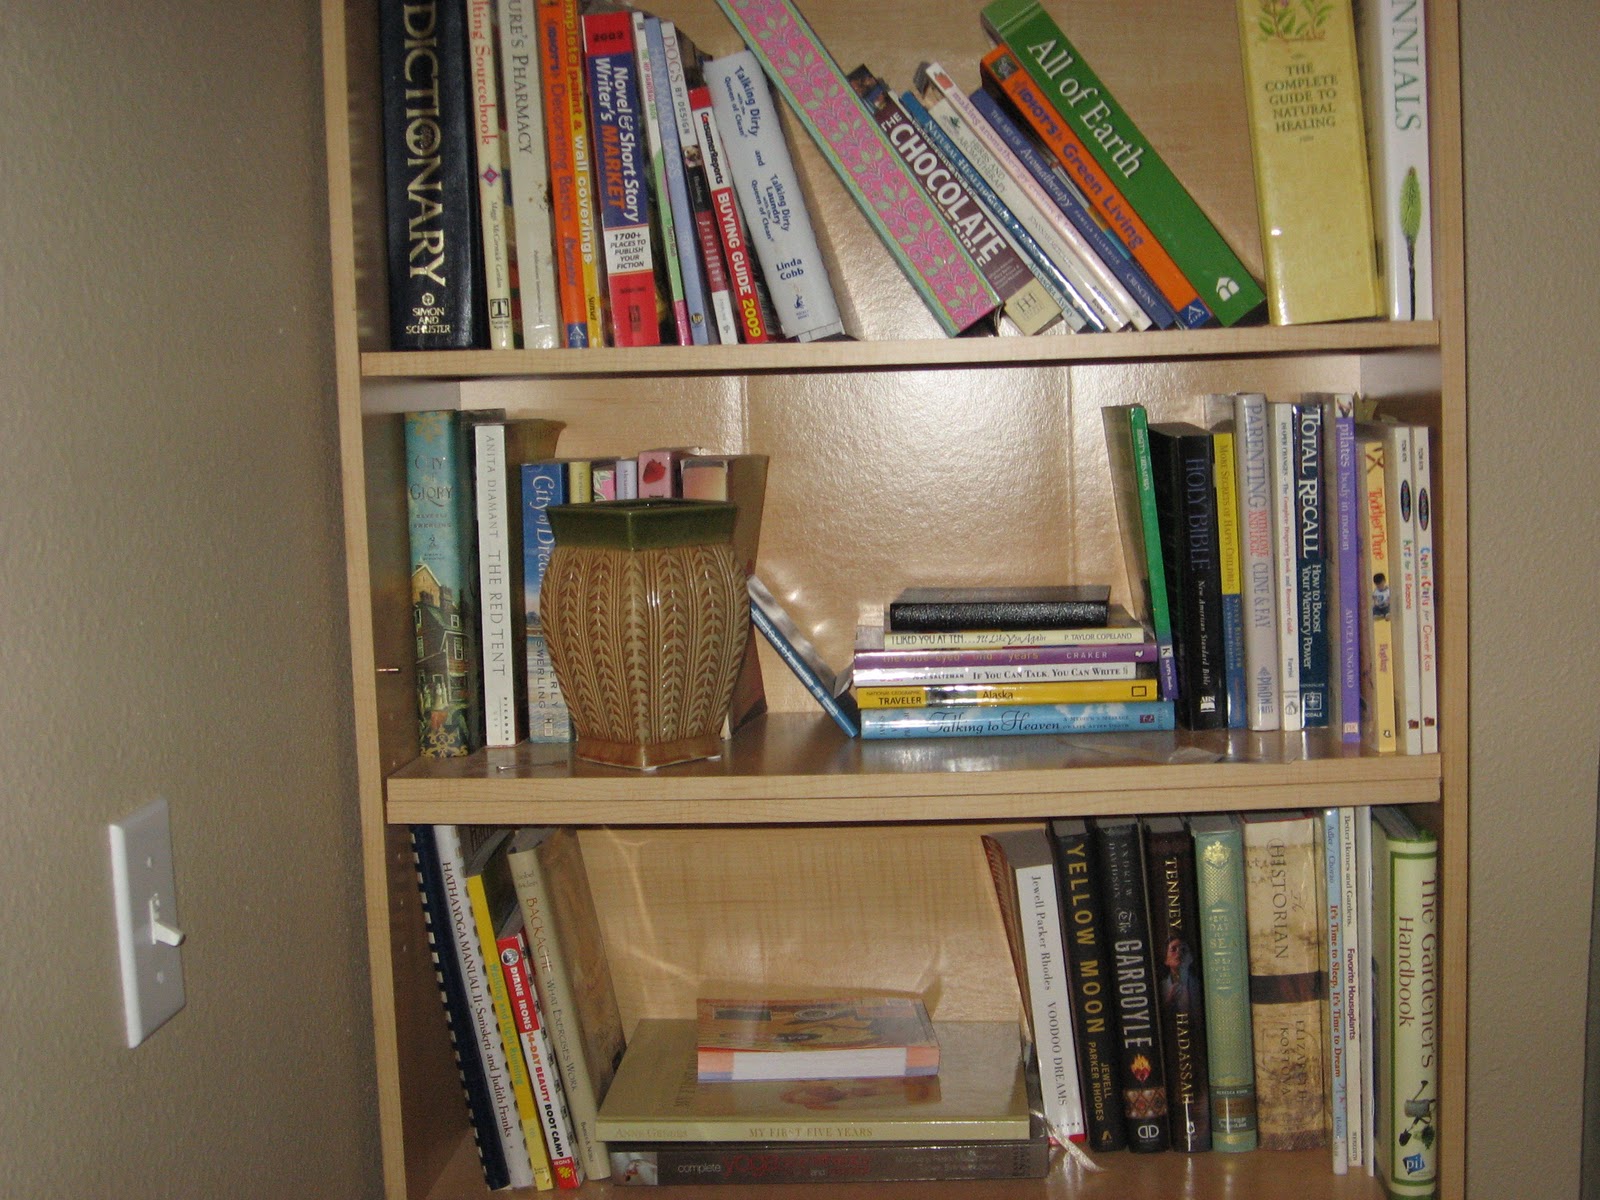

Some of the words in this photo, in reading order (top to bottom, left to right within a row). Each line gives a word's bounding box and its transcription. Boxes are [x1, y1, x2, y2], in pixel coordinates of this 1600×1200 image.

[663, 35, 682, 83] DOGS
[677, 101, 690, 135] DESIGN
[1264, 74, 1338, 92] COMPLETE
[1285, 63, 1314, 75] THE
[475, 46, 498, 145] Sourcebook
[512, 54, 532, 154] PHARMACY
[568, 70, 582, 117] paint
[595, 57, 616, 121] Writer's
[613, 66, 632, 113] Novel
[735, 65, 755, 106] Talking
[748, 108, 763, 138] Dirty
[1269, 89, 1312, 106] GUIDE
[1316, 88, 1337, 100] TO
[552, 84, 568, 170] Decorating
[1027, 39, 1074, 80] All
[1059, 78, 1099, 108] of
[1080, 99, 1145, 179] Earth
[1273, 104, 1336, 120] NATURAL
[1276, 116, 1336, 133] HEALING
[404, 3, 446, 287] DICTIONARY
[573, 135, 590, 174] wall
[620, 132, 637, 176] Short
[755, 151, 765, 167] and
[926, 120, 960, 162] NATURAL
[601, 125, 624, 209] MARKET
[1019, 87, 1059, 135] IDIOT'S
[1063, 144, 1105, 196] Green
[1103, 194, 1145, 249] Living
[559, 176, 573, 222] Basics
[624, 179, 639, 223] Story
[766, 186, 782, 226] Laundry
[770, 174, 786, 208] Talking
[782, 209, 793, 232] Dirty
[889, 123, 1007, 262] CHOCOLATE
[577, 176, 595, 265] coverings
[613, 232, 641, 240] 1700+
[1021, 149, 1073, 207] Aromatherapy
[1125, 272, 1158, 308] CRESCENT
[610, 241, 636, 249] PLACES
[614, 247, 644, 256] PUBLISH
[616, 261, 644, 270] FICTION
[718, 192, 741, 249] BUYING
[732, 251, 752, 296] GUIDE
[742, 298, 762, 338] 2009
[776, 258, 803, 272] Linda
[780, 268, 804, 281] Cobb
[405, 324, 451, 334] SCHUSTER
[412, 307, 445, 317] SIMON
[418, 315, 439, 324] AND
[485, 435, 497, 473] ANITA
[1243, 404, 1266, 508] PARENTING
[1301, 406, 1321, 474] TOTAL
[1336, 422, 1354, 468] pilates
[529, 475, 556, 512] City
[1186, 459, 1208, 509] HOLY
[1220, 471, 1230, 508] SECRETS
[1340, 472, 1350, 497] body
[487, 479, 499, 539] DIAMANT
[1298, 478, 1321, 559] RECALL
[1369, 488, 1386, 527] Toddler
[1188, 514, 1212, 571] BIBLE
[1342, 513, 1350, 550] motion
[1371, 527, 1387, 561] Time
[488, 550, 502, 586] THE
[1253, 562, 1270, 595] CLINE
[1302, 565, 1311, 591] Your
[1312, 563, 1321, 585] How
[489, 592, 503, 624] RED
[1312, 588, 1321, 599] to
[1198, 599, 1207, 631] American
[1255, 610, 1271, 629] FAY
[1301, 593, 1313, 638] Memory
[1312, 601, 1322, 633] Boost
[1345, 608, 1353, 645] ALYCEA
[490, 628, 506, 677] TENT
[896, 634, 918, 645] LIKED
[919, 634, 935, 645] YOU
[936, 634, 948, 644] AT
[1066, 651, 1108, 659] CRAKER
[1071, 633, 1096, 641] TAYLOR
[1096, 632, 1133, 640] COPELAND
[1200, 633, 1210, 667] Standard
[1303, 638, 1313, 670] Power
[1423, 624, 1433, 652] Clever
[536, 639, 548, 709] SWERLING
[984, 671, 1001, 680] YOU
[1004, 670, 1022, 679] CAN
[1052, 668, 1069, 678] YOU
[1071, 667, 1090, 677] CAN
[1092, 666, 1120, 676] WRITE
[1345, 646, 1354, 689] UNGARO
[879, 696, 922, 705] TRAVELER
[982, 690, 1014, 700] Alaska
[926, 710, 984, 734] Talking
[987, 721, 999, 732] to
[1001, 710, 1060, 731] Heaven
[1327, 824, 1336, 848] Adler
[1344, 815, 1353, 840] Better
[1108, 842, 1121, 898] DAVIDSON
[1120, 842, 1133, 897] ANDREW
[1345, 841, 1353, 871] Homes
[443, 861, 460, 907] HATHA
[1031, 875, 1046, 909] Jewell
[1067, 843, 1096, 946] YELLOW
[1164, 856, 1183, 930] TENNEY
[1268, 843, 1289, 960] HISTORIAN
[452, 904, 466, 939] YOGA
[1330, 904, 1338, 920] It's
[1036, 912, 1047, 951] Parker
[1330, 921, 1338, 945] Time
[460, 940, 478, 993] MANUAL
[1331, 946, 1338, 959] to
[1347, 948, 1358, 983] Favorite
[1040, 951, 1054, 992] Rhodes
[1330, 961, 1341, 991] Sleep,
[1399, 916, 1416, 1028] Handbook
[526, 897, 552, 974] BACKACHE
[553, 1009, 571, 1062] EXERCISES
[566, 1061, 578, 1092] WORK
[1079, 959, 1106, 1034] MOON
[1114, 939, 1153, 1049] GARGOYLE
[1348, 984, 1359, 1041] Houseplants
[1047, 1001, 1063, 1054] VOODOO
[1333, 1007, 1341, 1033] Time
[486, 1053, 499, 1072] and
[510, 966, 525, 997] DIANE
[518, 999, 533, 1030] IRONS
[526, 1031, 541, 1067] 14-DAY
[535, 1066, 551, 1103] BEAUTY
[544, 1103, 557, 1130] BOOT
[551, 1130, 564, 1158] CAMP
[1087, 1041, 1100, 1079] PARKER
[1175, 1012, 1194, 1105] HADASSAH
[1279, 1026, 1291, 1096] KOSTOVA
[1295, 1019, 1308, 1100] ELIZABETH
[1334, 1047, 1342, 1078] Dream
[489, 1073, 504, 1104] Judith
[1053, 1057, 1068, 1107] DREAMS
[1100, 1062, 1112, 1099] JEWELL
[1092, 1082, 1105, 1122] RHODES
[499, 1104, 512, 1138] Franks
[750, 1127, 767, 1137] MY
[769, 1127, 801, 1137] FIRST
[806, 1127, 832, 1137] FIVE
[836, 1127, 873, 1137] YEARS
[677, 1163, 721, 1174] complete
[722, 1153, 778, 1178] yoga
